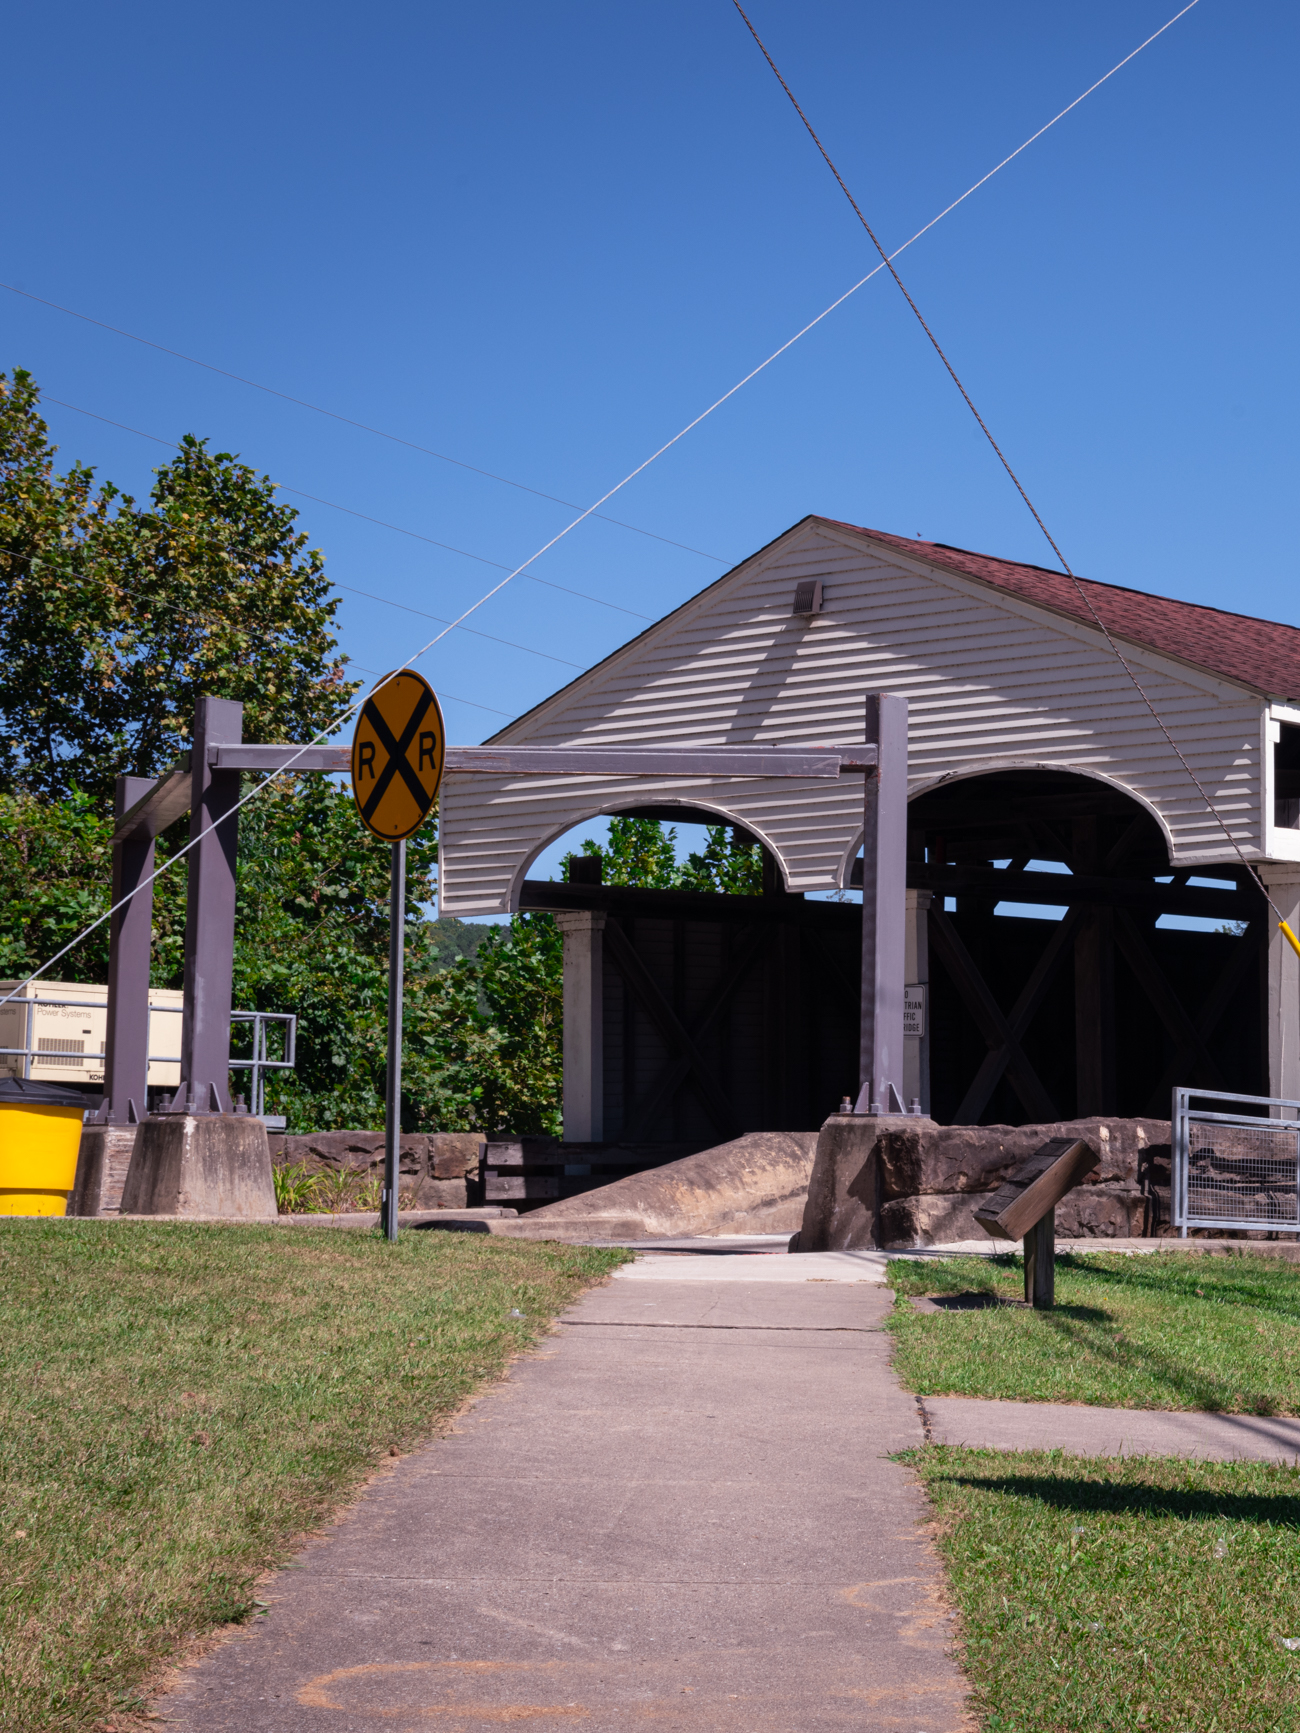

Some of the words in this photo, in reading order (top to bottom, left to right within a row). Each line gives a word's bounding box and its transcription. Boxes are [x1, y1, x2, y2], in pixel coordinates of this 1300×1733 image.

[358, 741, 376, 781] R
[418, 730, 437, 772] R
[904, 1001, 922, 1010] TRIAN
[37, 1008, 59, 1017] Power
[61, 1009, 92, 1019] Systems
[903, 1012, 916, 1021] FFIC
